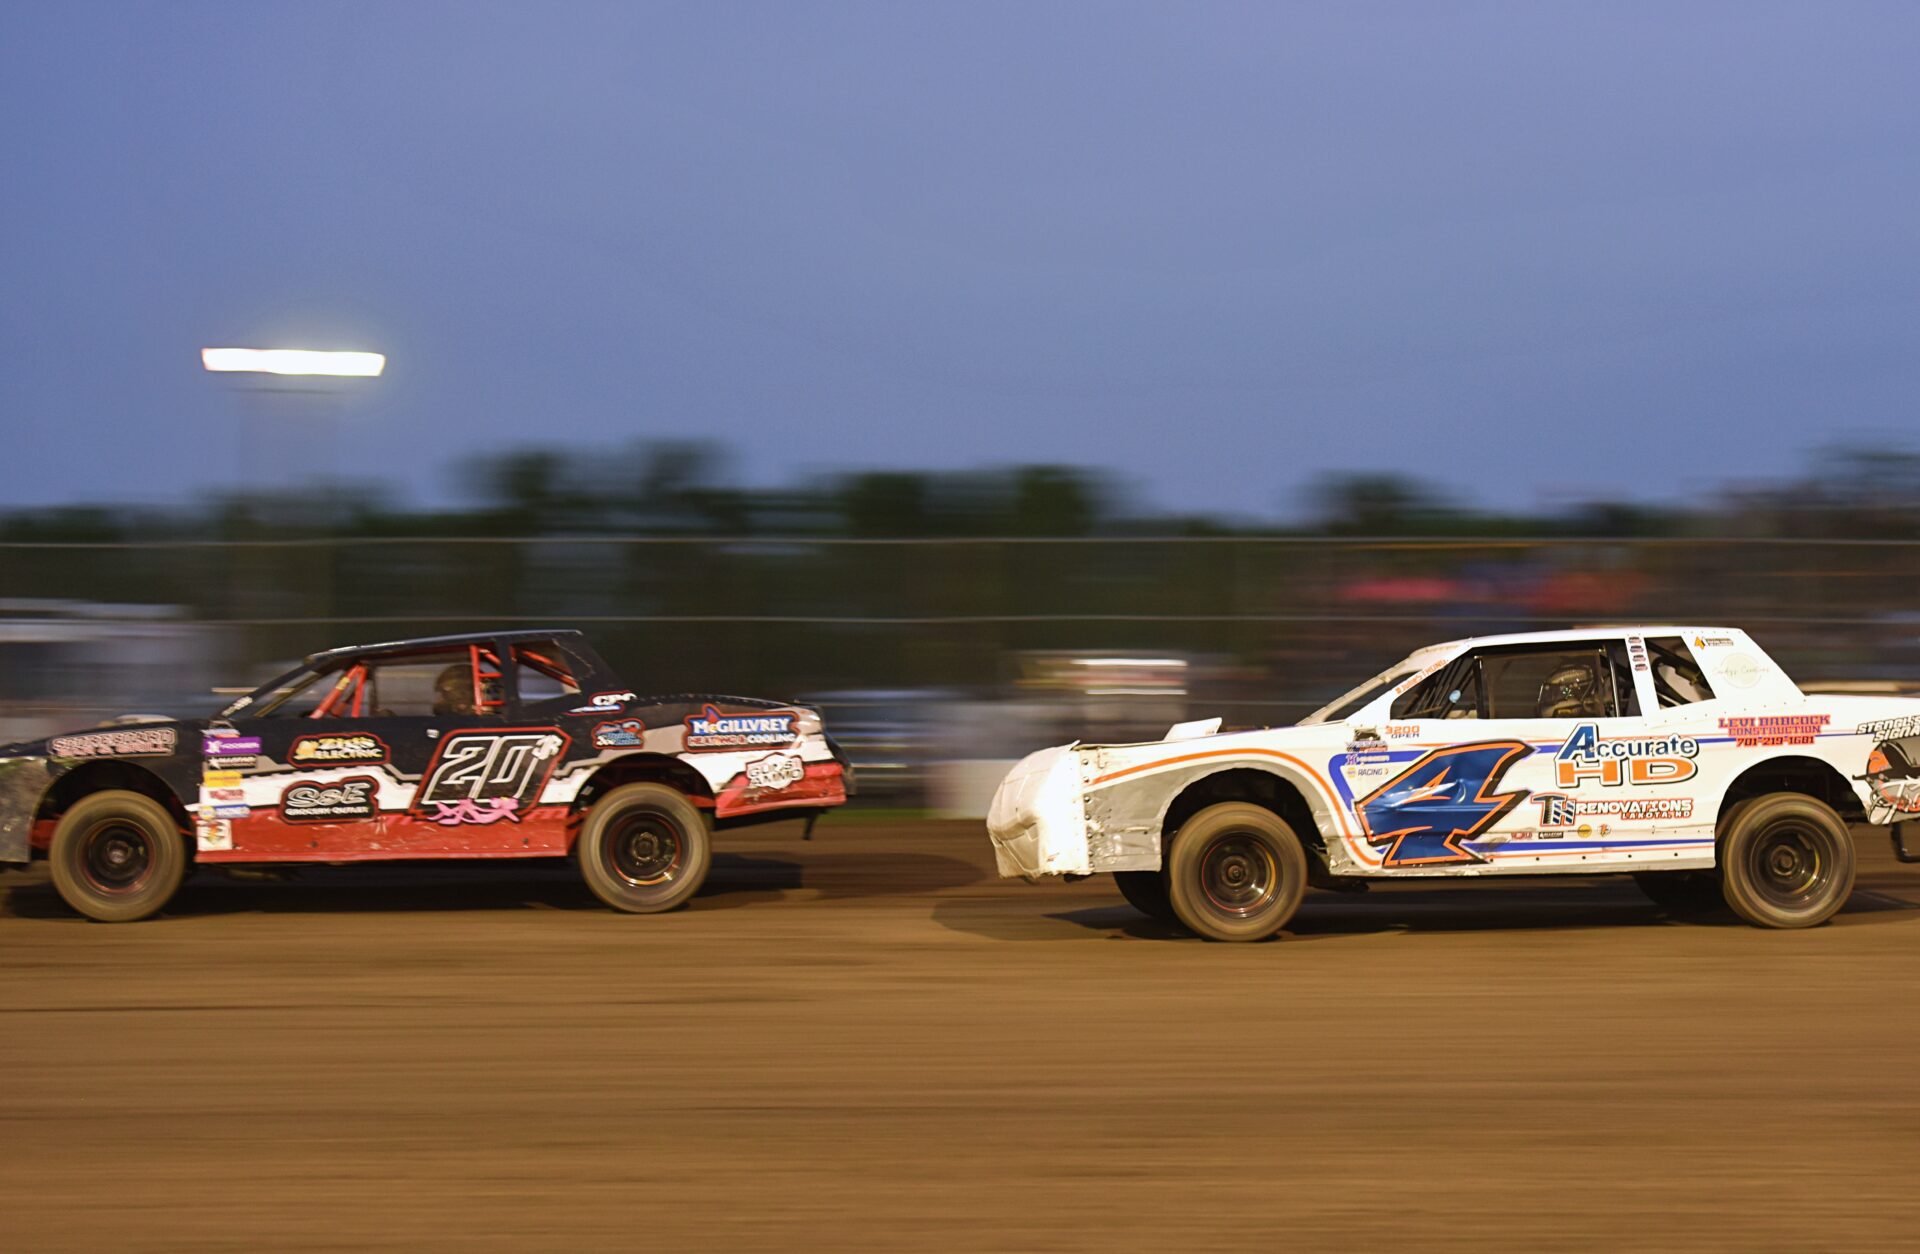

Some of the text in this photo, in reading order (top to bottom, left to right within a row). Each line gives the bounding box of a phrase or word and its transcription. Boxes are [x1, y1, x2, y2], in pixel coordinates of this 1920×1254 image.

[1718, 714, 1831, 728] LEVI BABCOCK
[747, 732, 797, 744] COOLING
[1728, 725, 1822, 736] CONSTRUCTION
[1556, 723, 1696, 760] Accurate
[421, 734, 553, 804] 20
[1557, 757, 1697, 786] HD
[1355, 739, 1535, 869] 4
[1576, 799, 1694, 814] RENOVATIONS
[1621, 809, 1694, 820] LAKOTA, ND
